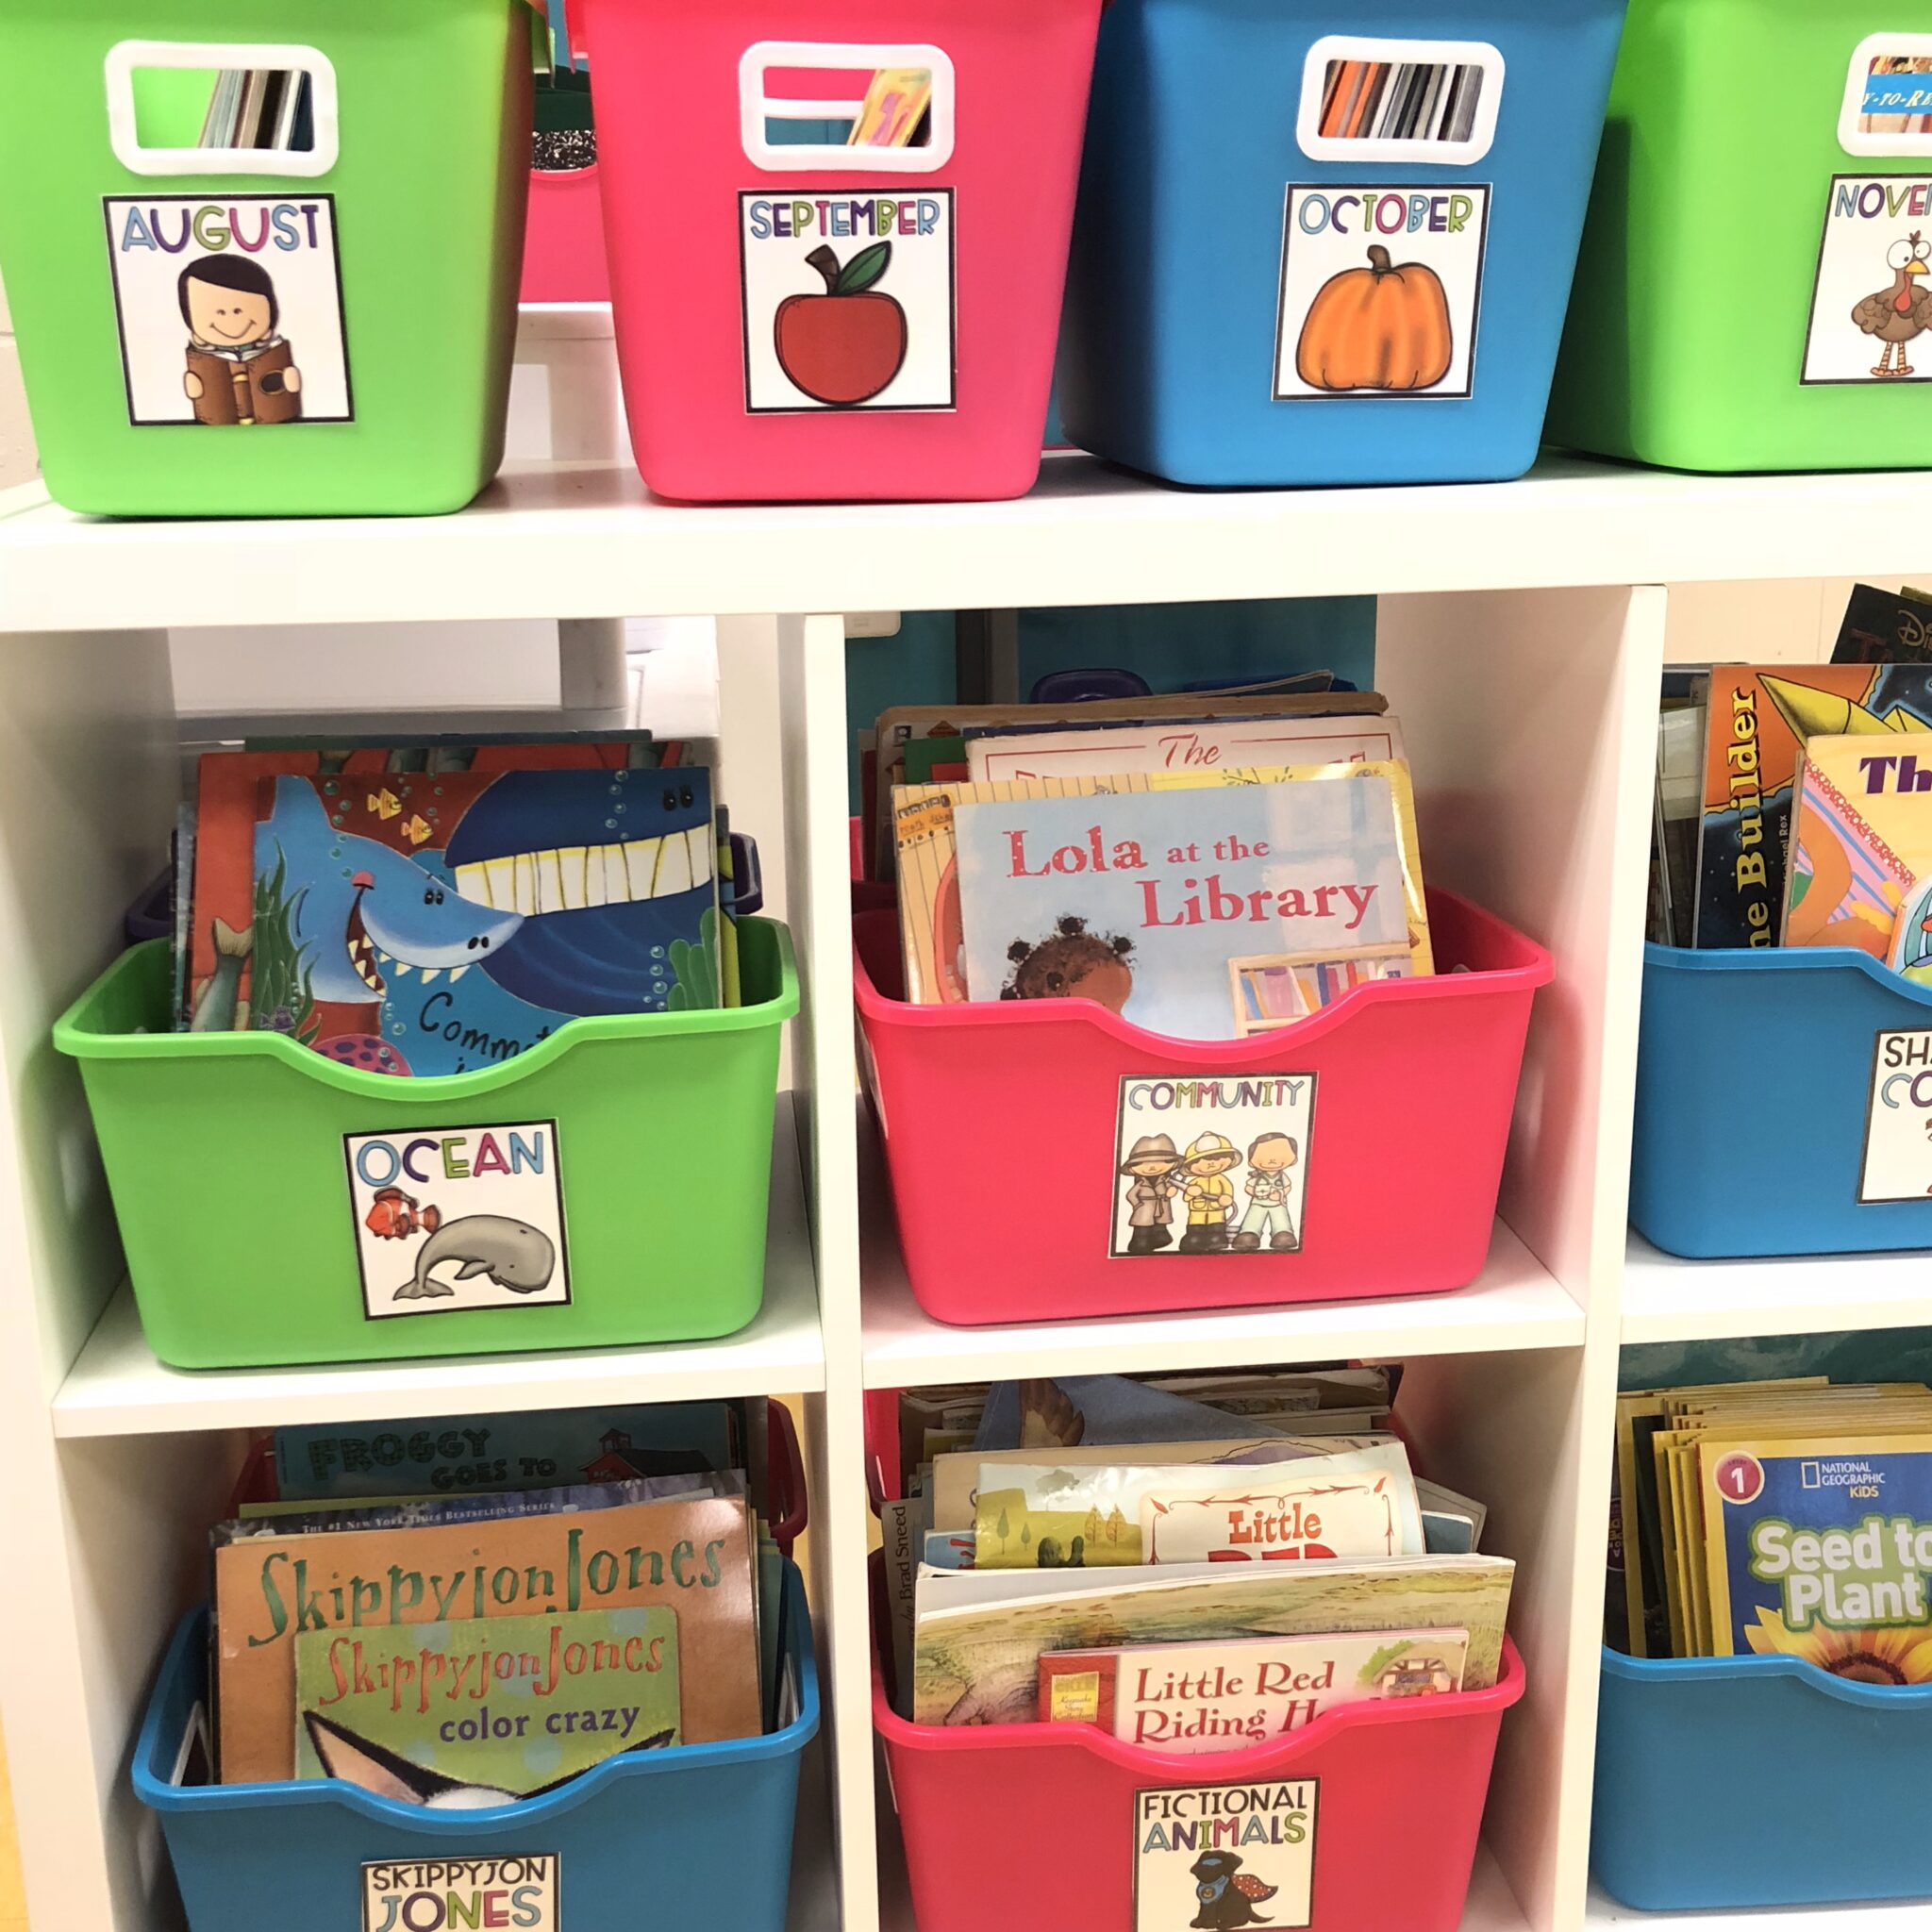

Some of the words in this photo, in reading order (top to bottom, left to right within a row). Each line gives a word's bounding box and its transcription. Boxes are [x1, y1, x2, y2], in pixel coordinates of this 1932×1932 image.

[750, 198, 941, 240] SEPTEMBER
[1298, 193, 1473, 235] OCTOBER
[1835, 183, 1932, 218] NOVE
[122, 204, 319, 254] AUGUST
[1158, 733, 1222, 768] The
[1727, 687, 1768, 894] Builder
[1002, 825, 1148, 878] Lola
[1166, 842, 1202, 864] at
[1213, 835, 1270, 861] the
[1134, 874, 1378, 929] Library
[1129, 1079, 1306, 1110] COMMUNITY
[357, 1132, 544, 1188] OCEAN
[308, 1427, 491, 1480] FROGGY
[430, 1458, 508, 1490] GOES
[518, 1456, 557, 1477] TO
[1822, 1461, 1872, 1474] NATIONAL
[1731, 1467, 1744, 1493] 1
[1822, 1472, 1886, 1487] GEOGRAPHIC
[892, 1507, 908, 1557] Sneed
[1228, 1502, 1322, 1544] Little
[1757, 1522, 1884, 1574] Seed
[1894, 1524, 1932, 1568] to
[545, 1527, 725, 1613] Jones
[899, 1562, 913, 1601] Brad
[1790, 1573, 1923, 1623] Plant
[533, 1624, 665, 1696] Jones
[1134, 1666, 1243, 1703] Little
[1255, 1660, 1335, 1696] Red
[439, 1704, 529, 1743] color
[545, 1705, 641, 1738] crazy
[1133, 1708, 1267, 1743] Riding
[1144, 1786, 1307, 1820] FICTIONAL
[1142, 1811, 1307, 1854] ANIMALS
[373, 1857, 546, 1890] SKIPPYJON
[375, 1885, 543, 1932] JONES
